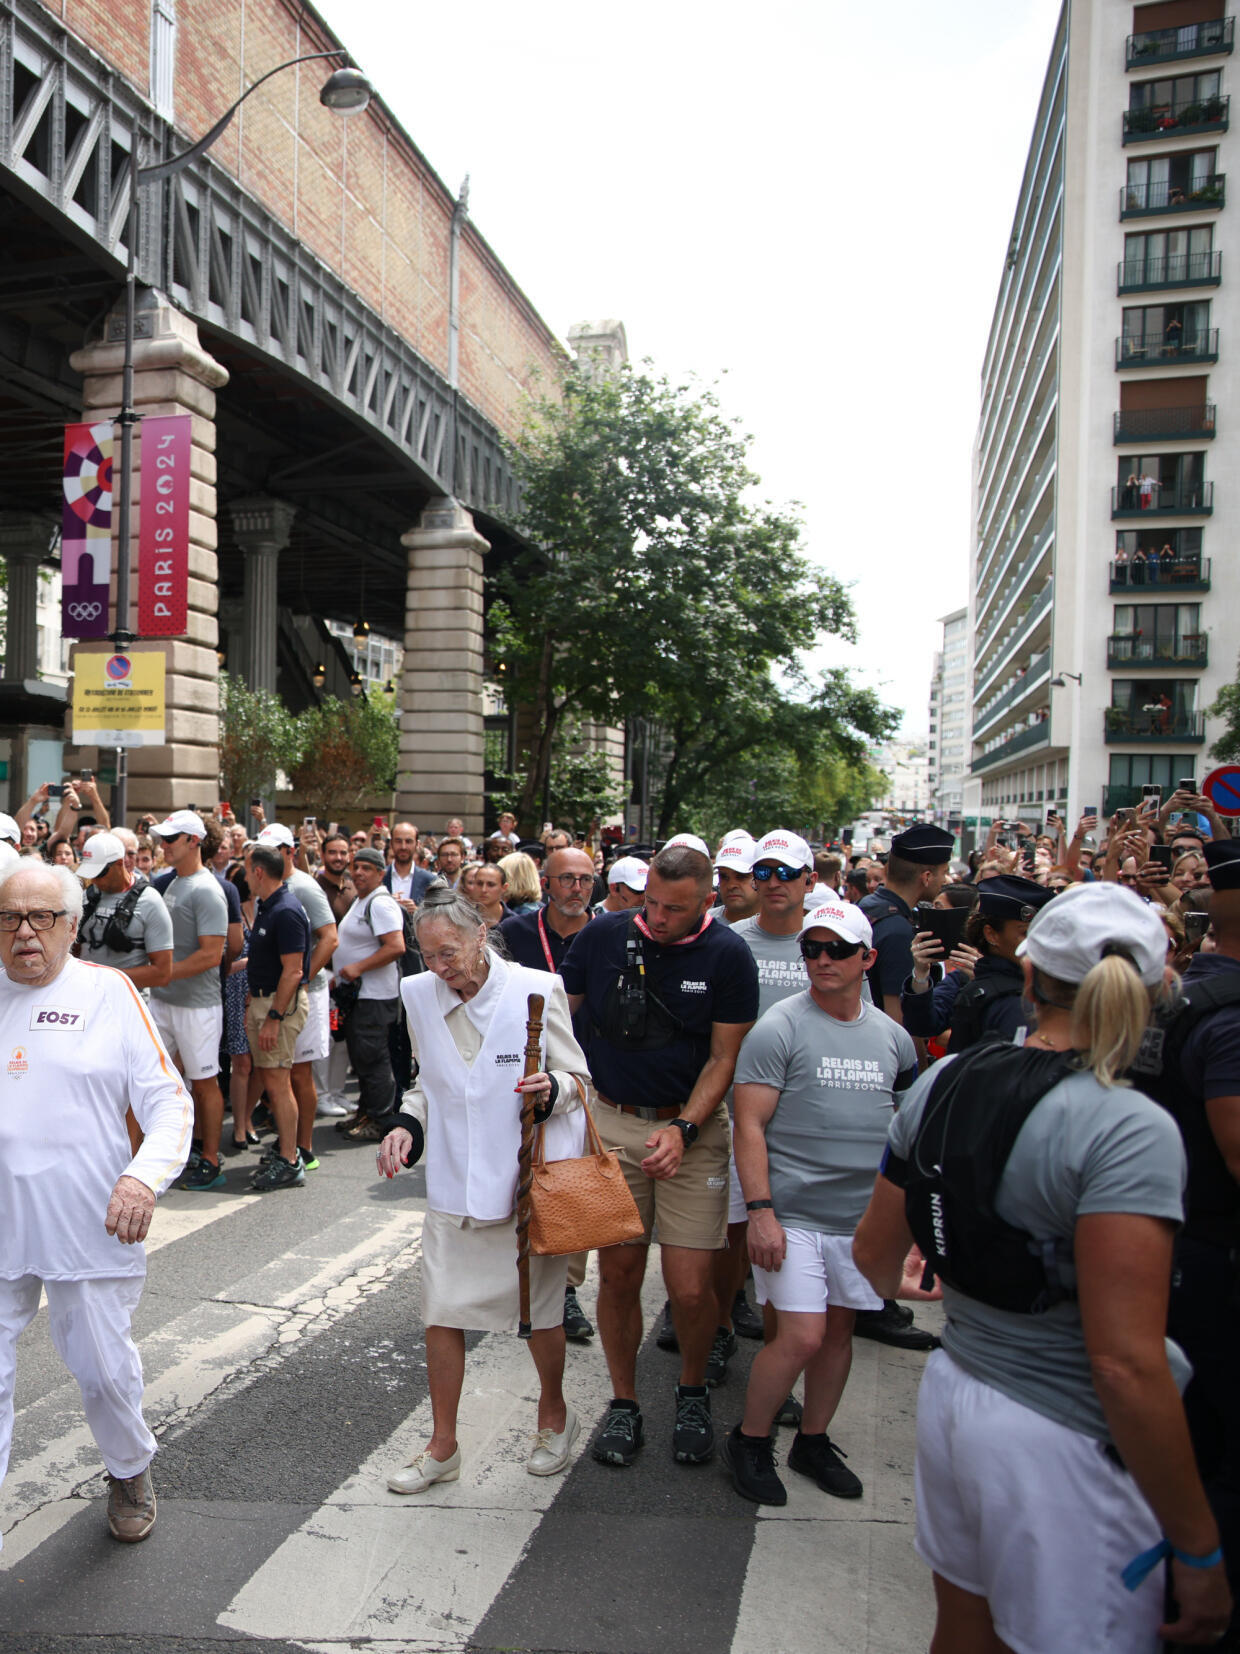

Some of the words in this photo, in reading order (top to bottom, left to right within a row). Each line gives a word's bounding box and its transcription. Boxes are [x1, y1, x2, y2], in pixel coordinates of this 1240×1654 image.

[156, 435, 176, 514] 2024
[757, 960, 788, 970] ELAIS
[759, 969, 809, 980] FLAMME
[822, 1057, 862, 1070] RELAIS
[864, 1060, 879, 1071] DE
[817, 1067, 833, 1078] LA
[834, 1069, 884, 1083] FLAMME
[821, 1080, 852, 1089] PARIS
[854, 1082, 881, 1091] 2024
[930, 1192, 946, 1257] KIPRUN
